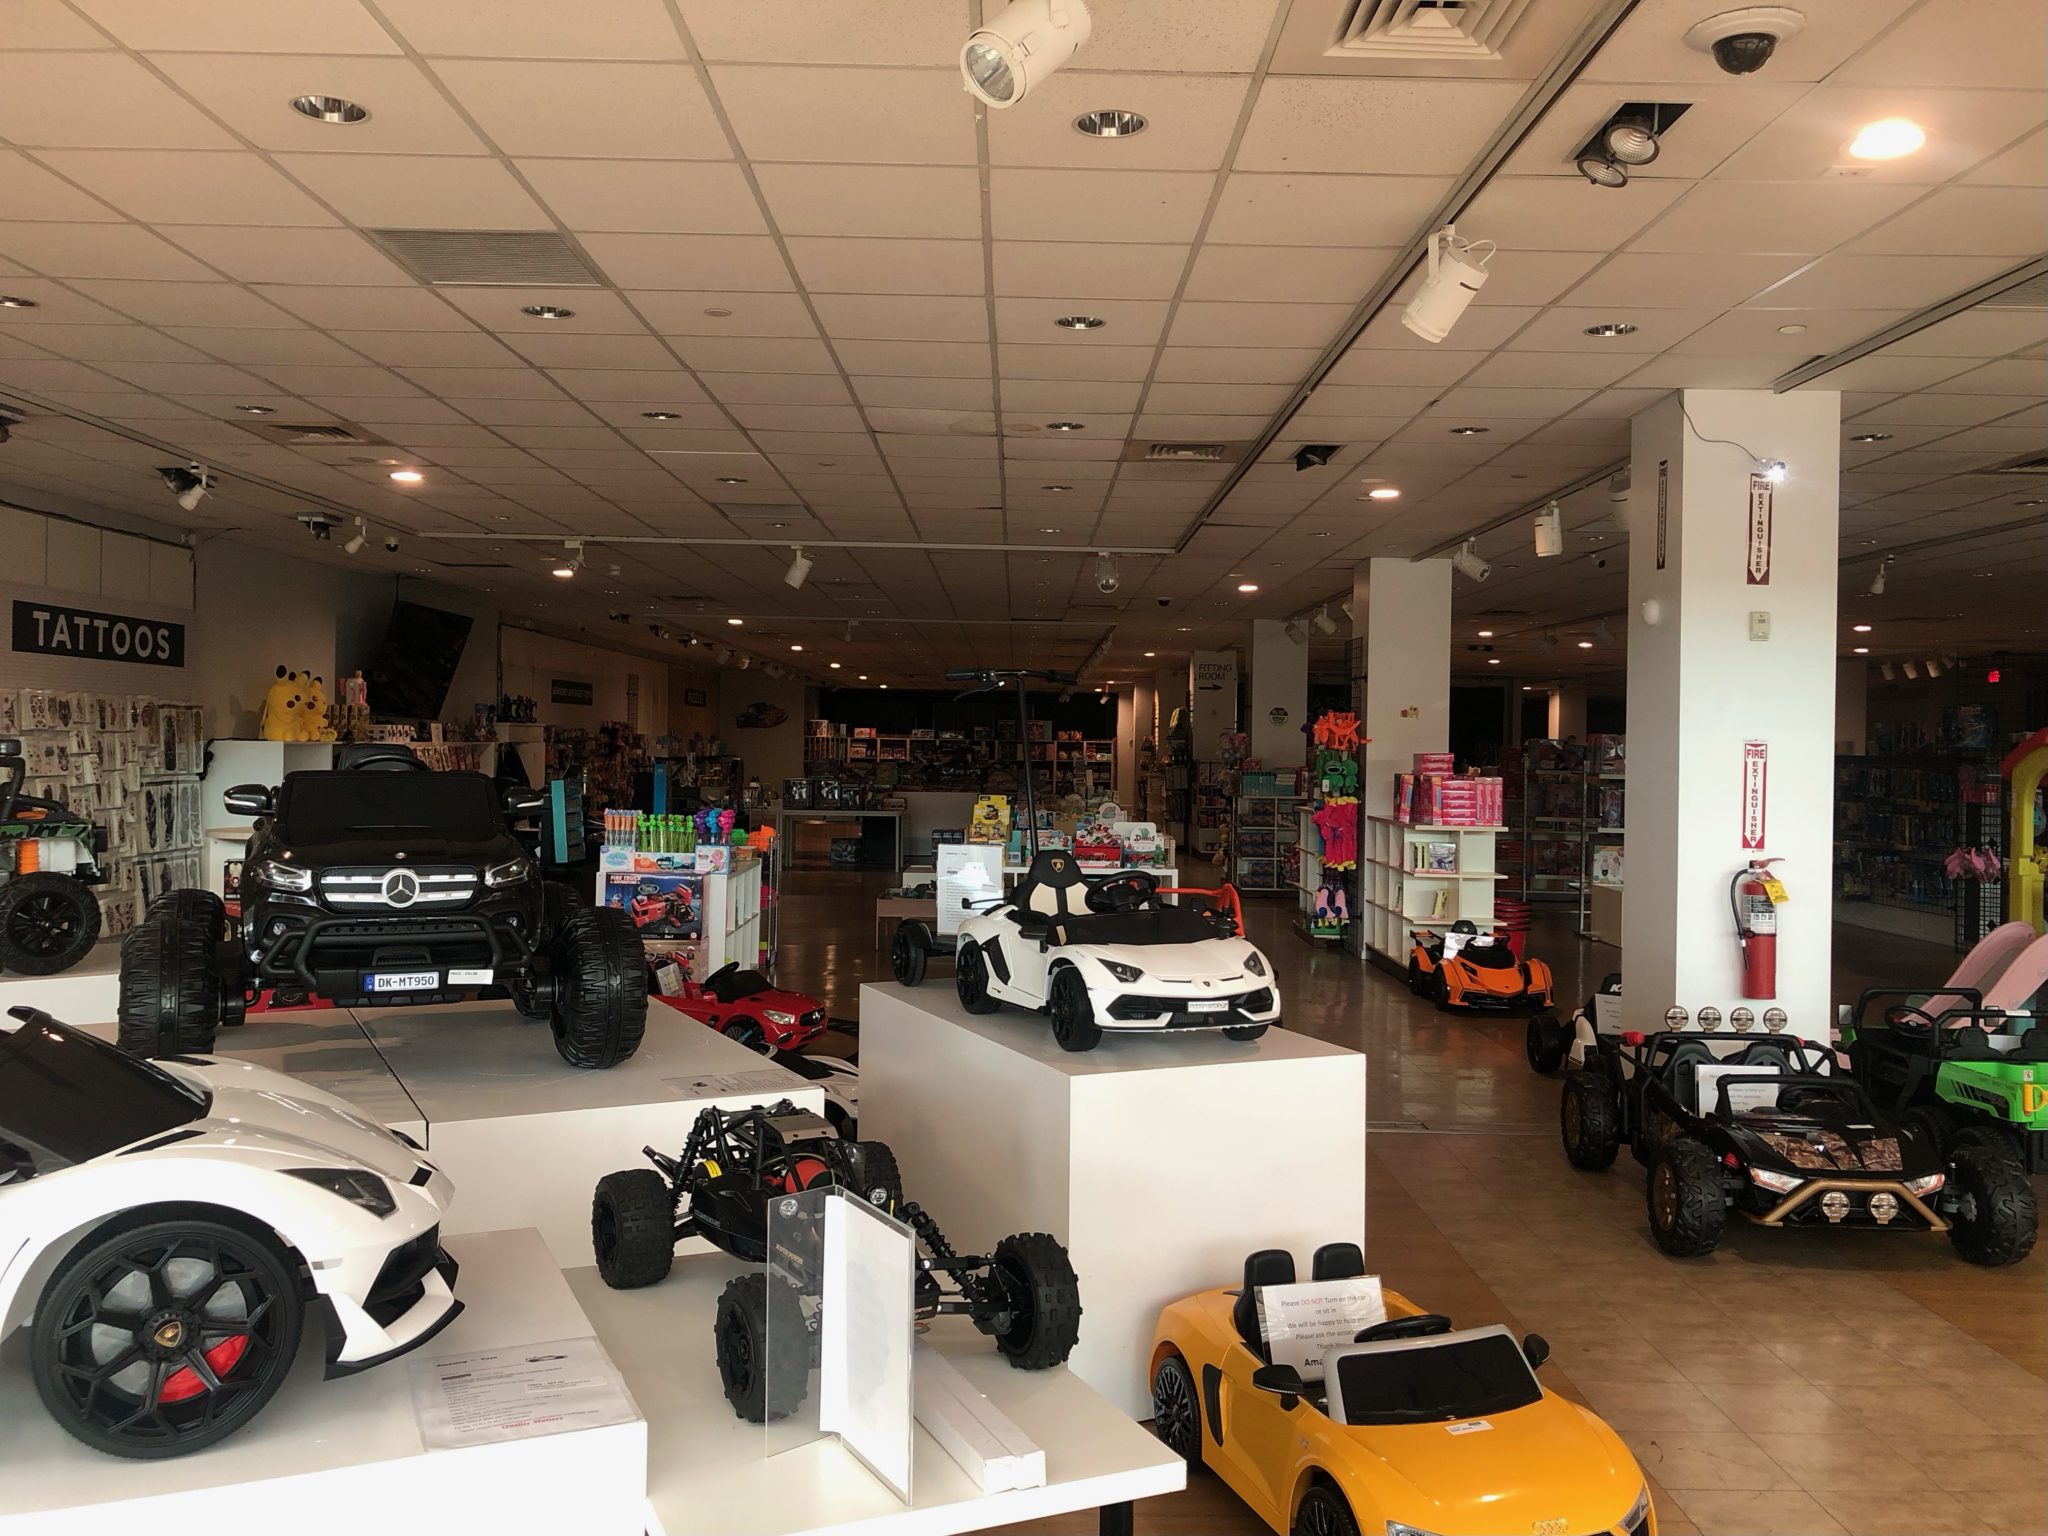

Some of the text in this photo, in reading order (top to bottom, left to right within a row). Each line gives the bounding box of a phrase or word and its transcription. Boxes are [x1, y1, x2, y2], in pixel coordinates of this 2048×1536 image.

[1753, 480, 1770, 490] FIRE
[1755, 493, 1764, 574] EXTINGUISHER
[32, 610, 170, 660] TATTOOS
[1199, 663, 1233, 672] FITTING
[1199, 672, 1226, 681] ROOM
[1746, 749, 1765, 759] FIRE
[1750, 761, 1759, 842] EXTINGUISHER
[378, 976, 435, 988] DK-MT950
